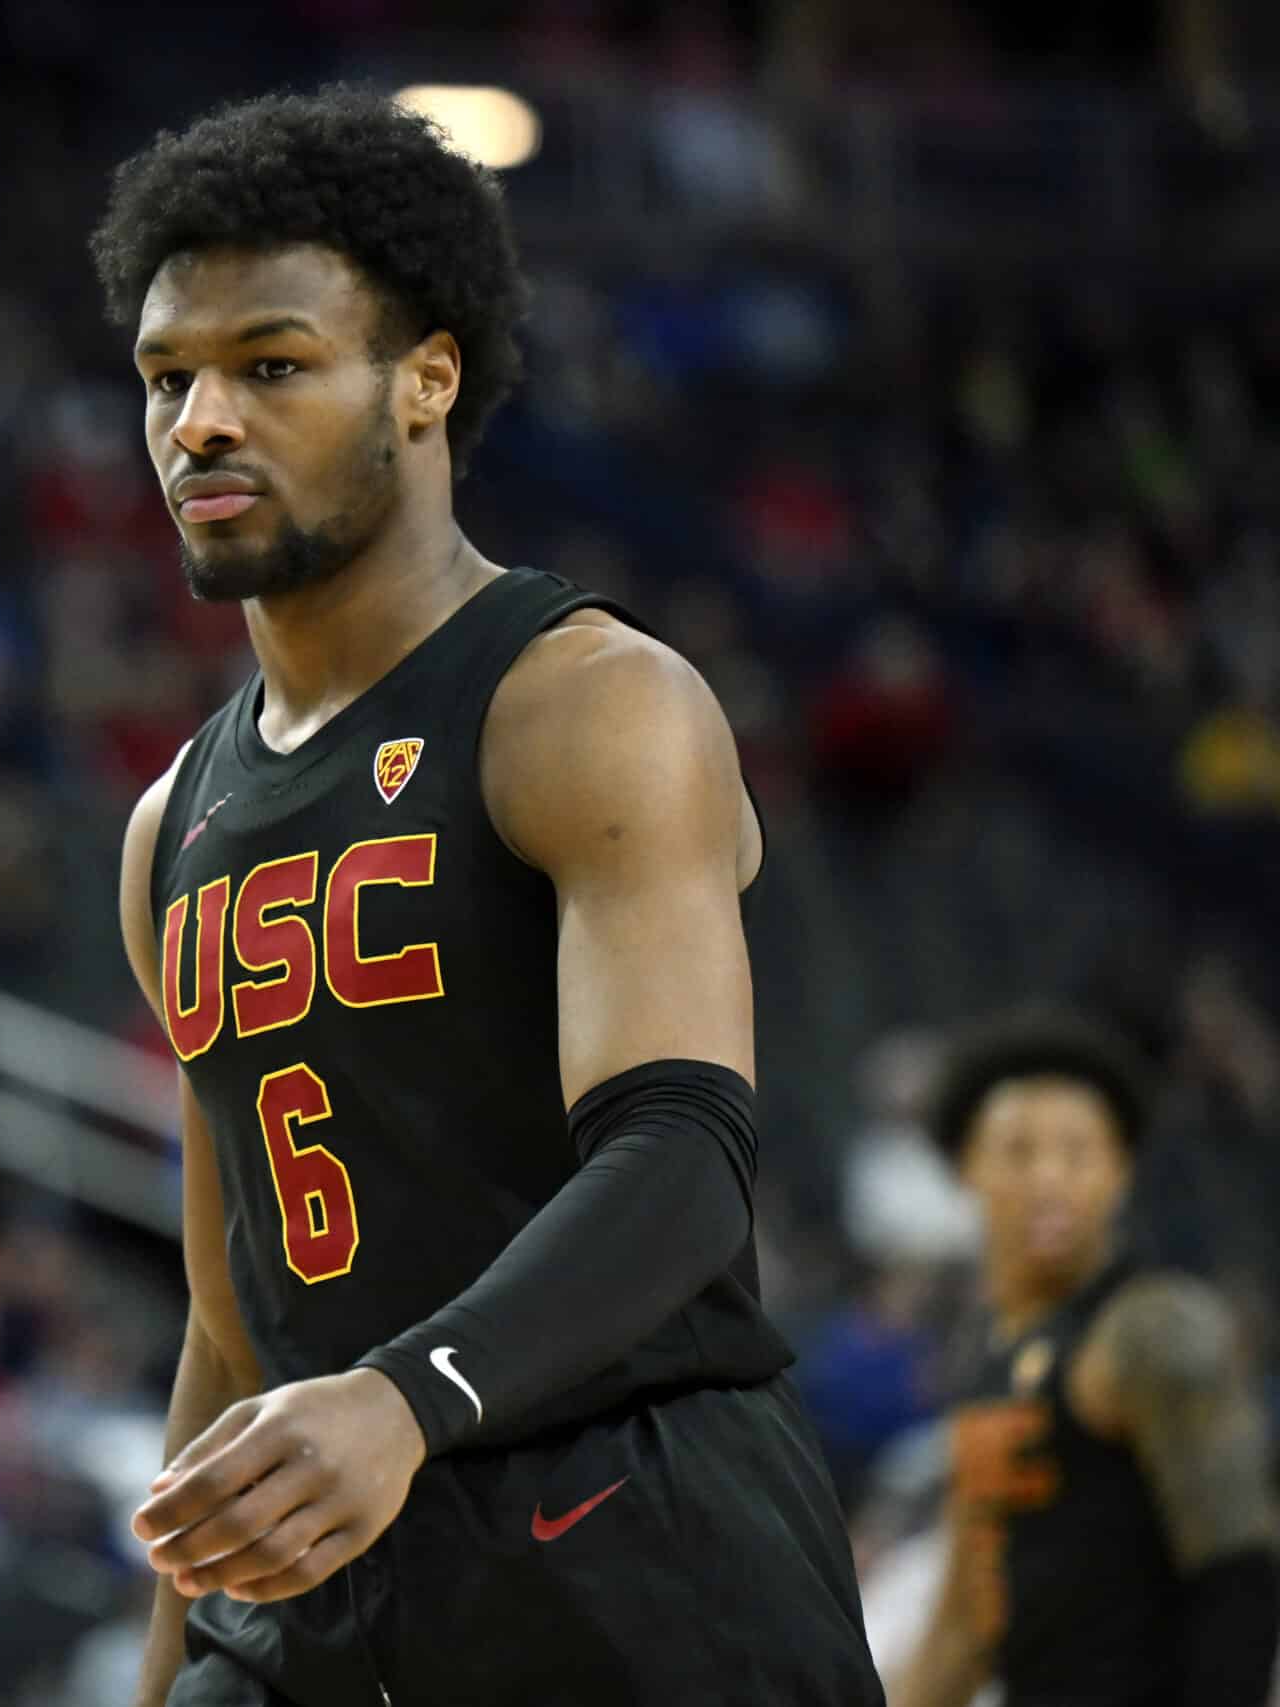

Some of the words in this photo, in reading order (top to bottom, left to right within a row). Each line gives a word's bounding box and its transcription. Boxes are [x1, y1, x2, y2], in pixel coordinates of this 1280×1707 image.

[378, 742, 420, 776] PAC
[381, 765, 406, 787] 12
[163, 833, 445, 1061] USC
[256, 1062, 360, 1285] 6
